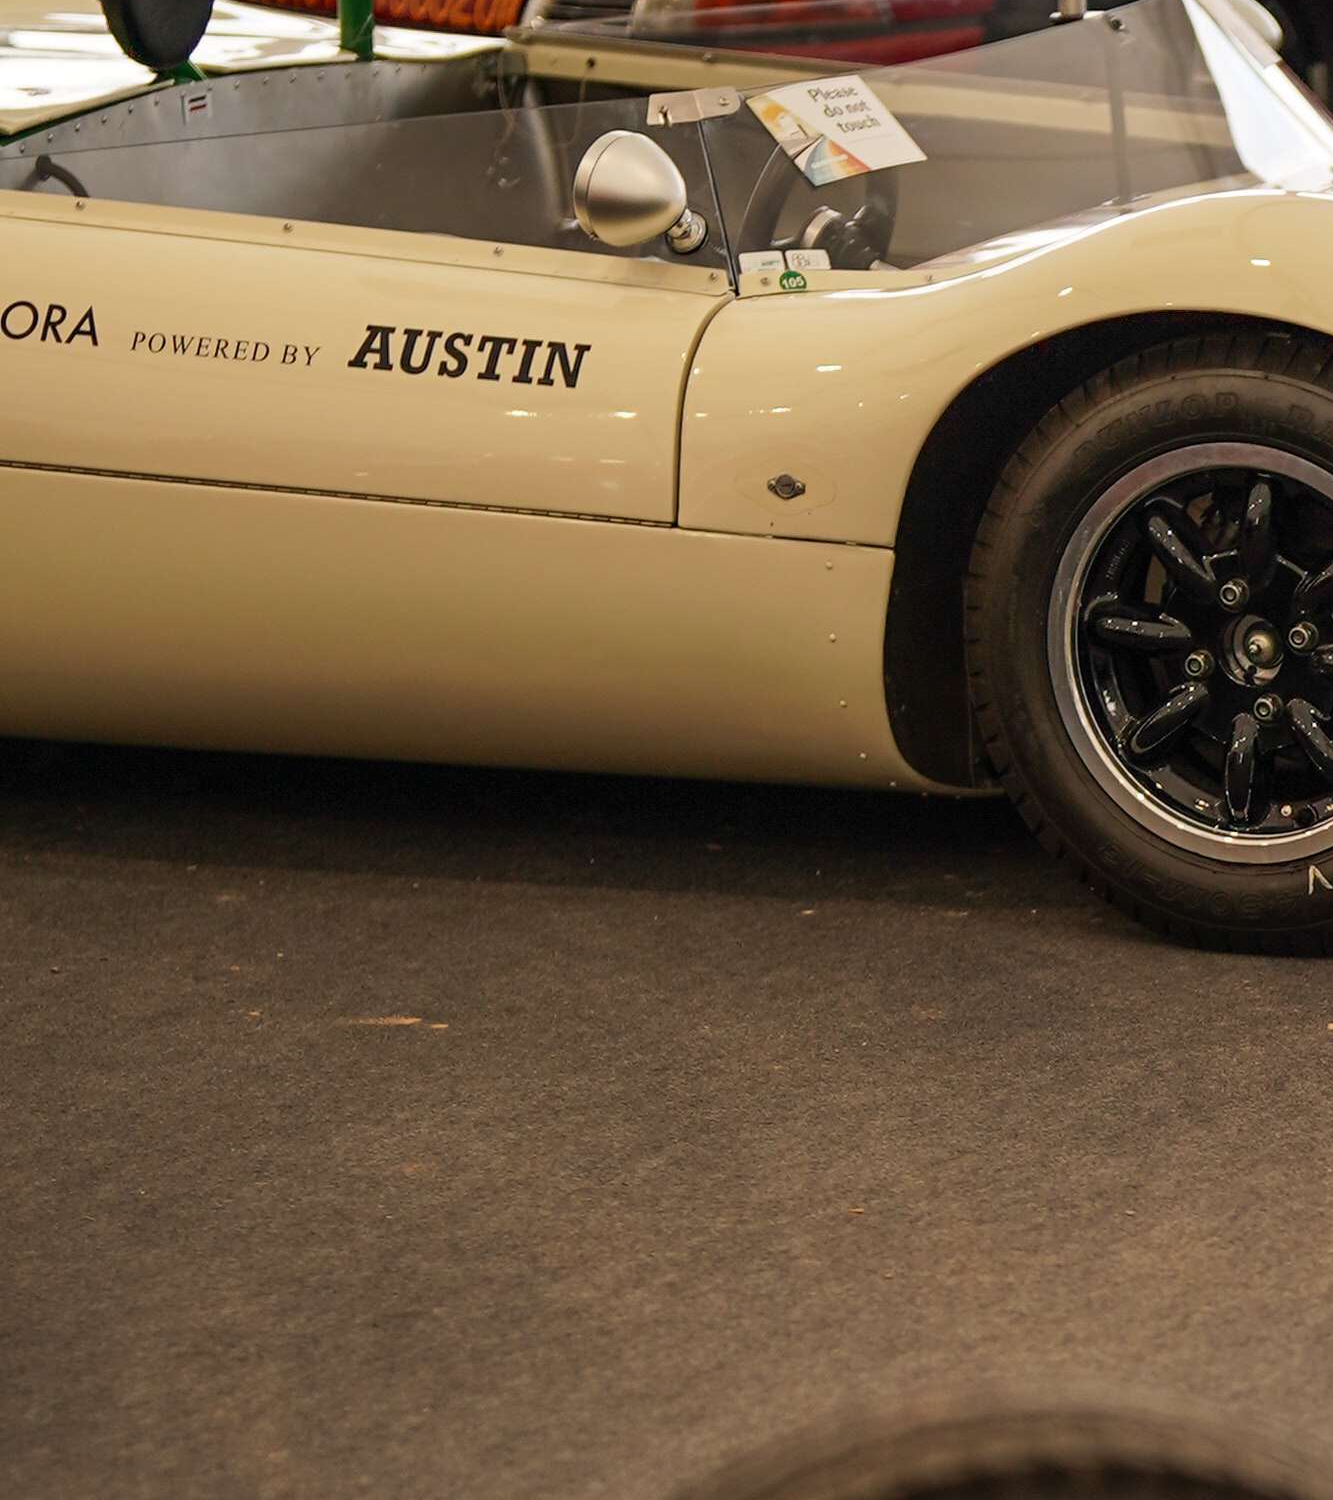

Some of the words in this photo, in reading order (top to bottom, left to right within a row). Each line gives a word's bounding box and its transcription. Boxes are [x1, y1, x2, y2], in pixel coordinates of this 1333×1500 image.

[807, 85, 859, 102] Please
[823, 103, 844, 118] do
[846, 100, 872, 114] not
[837, 115, 881, 133] touch
[782, 275, 805, 290] 105
[0, 300, 100, 347] ORA
[130, 331, 270, 363] POWERED
[281, 344, 322, 368] BY
[347, 324, 592, 389] AUSTIN
